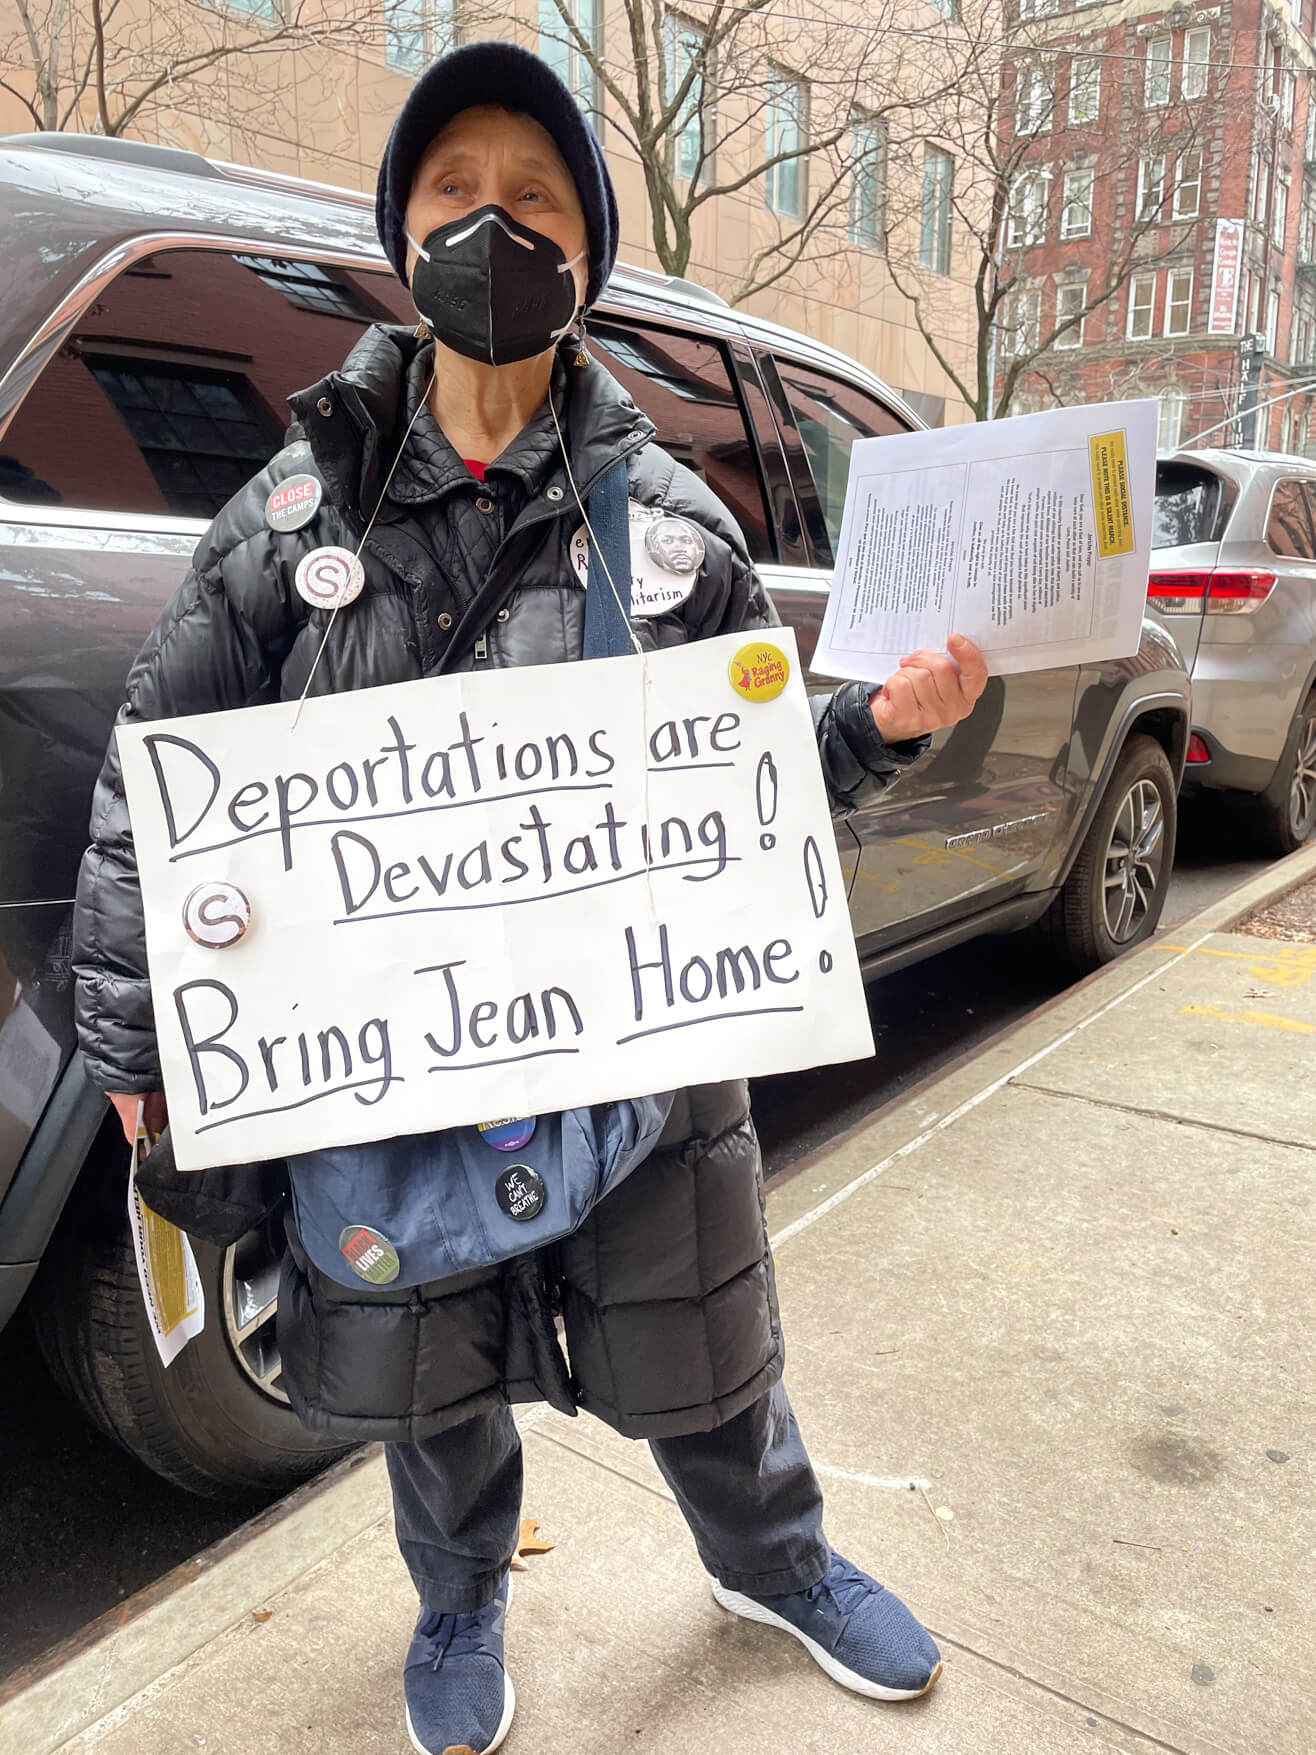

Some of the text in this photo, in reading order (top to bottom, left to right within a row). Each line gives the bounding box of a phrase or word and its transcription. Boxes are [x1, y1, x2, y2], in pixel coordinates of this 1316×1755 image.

[1240, 338, 1254, 353] THE
[1239, 358, 1250, 405] HALF
[272, 483, 312, 508] CLOSE
[272, 499, 314, 521] THE CAMPS
[752, 661, 783, 677] Raging
[756, 652, 772, 664] NYC
[754, 671, 784, 688] Granny
[144, 710, 742, 871] Deportations are
[173, 977, 393, 1116] Bring
[414, 960, 583, 1058] Jean
[504, 1172, 521, 1191] WE
[510, 1190, 539, 1216] BREATHE
[356, 1245, 384, 1271] LIVES
